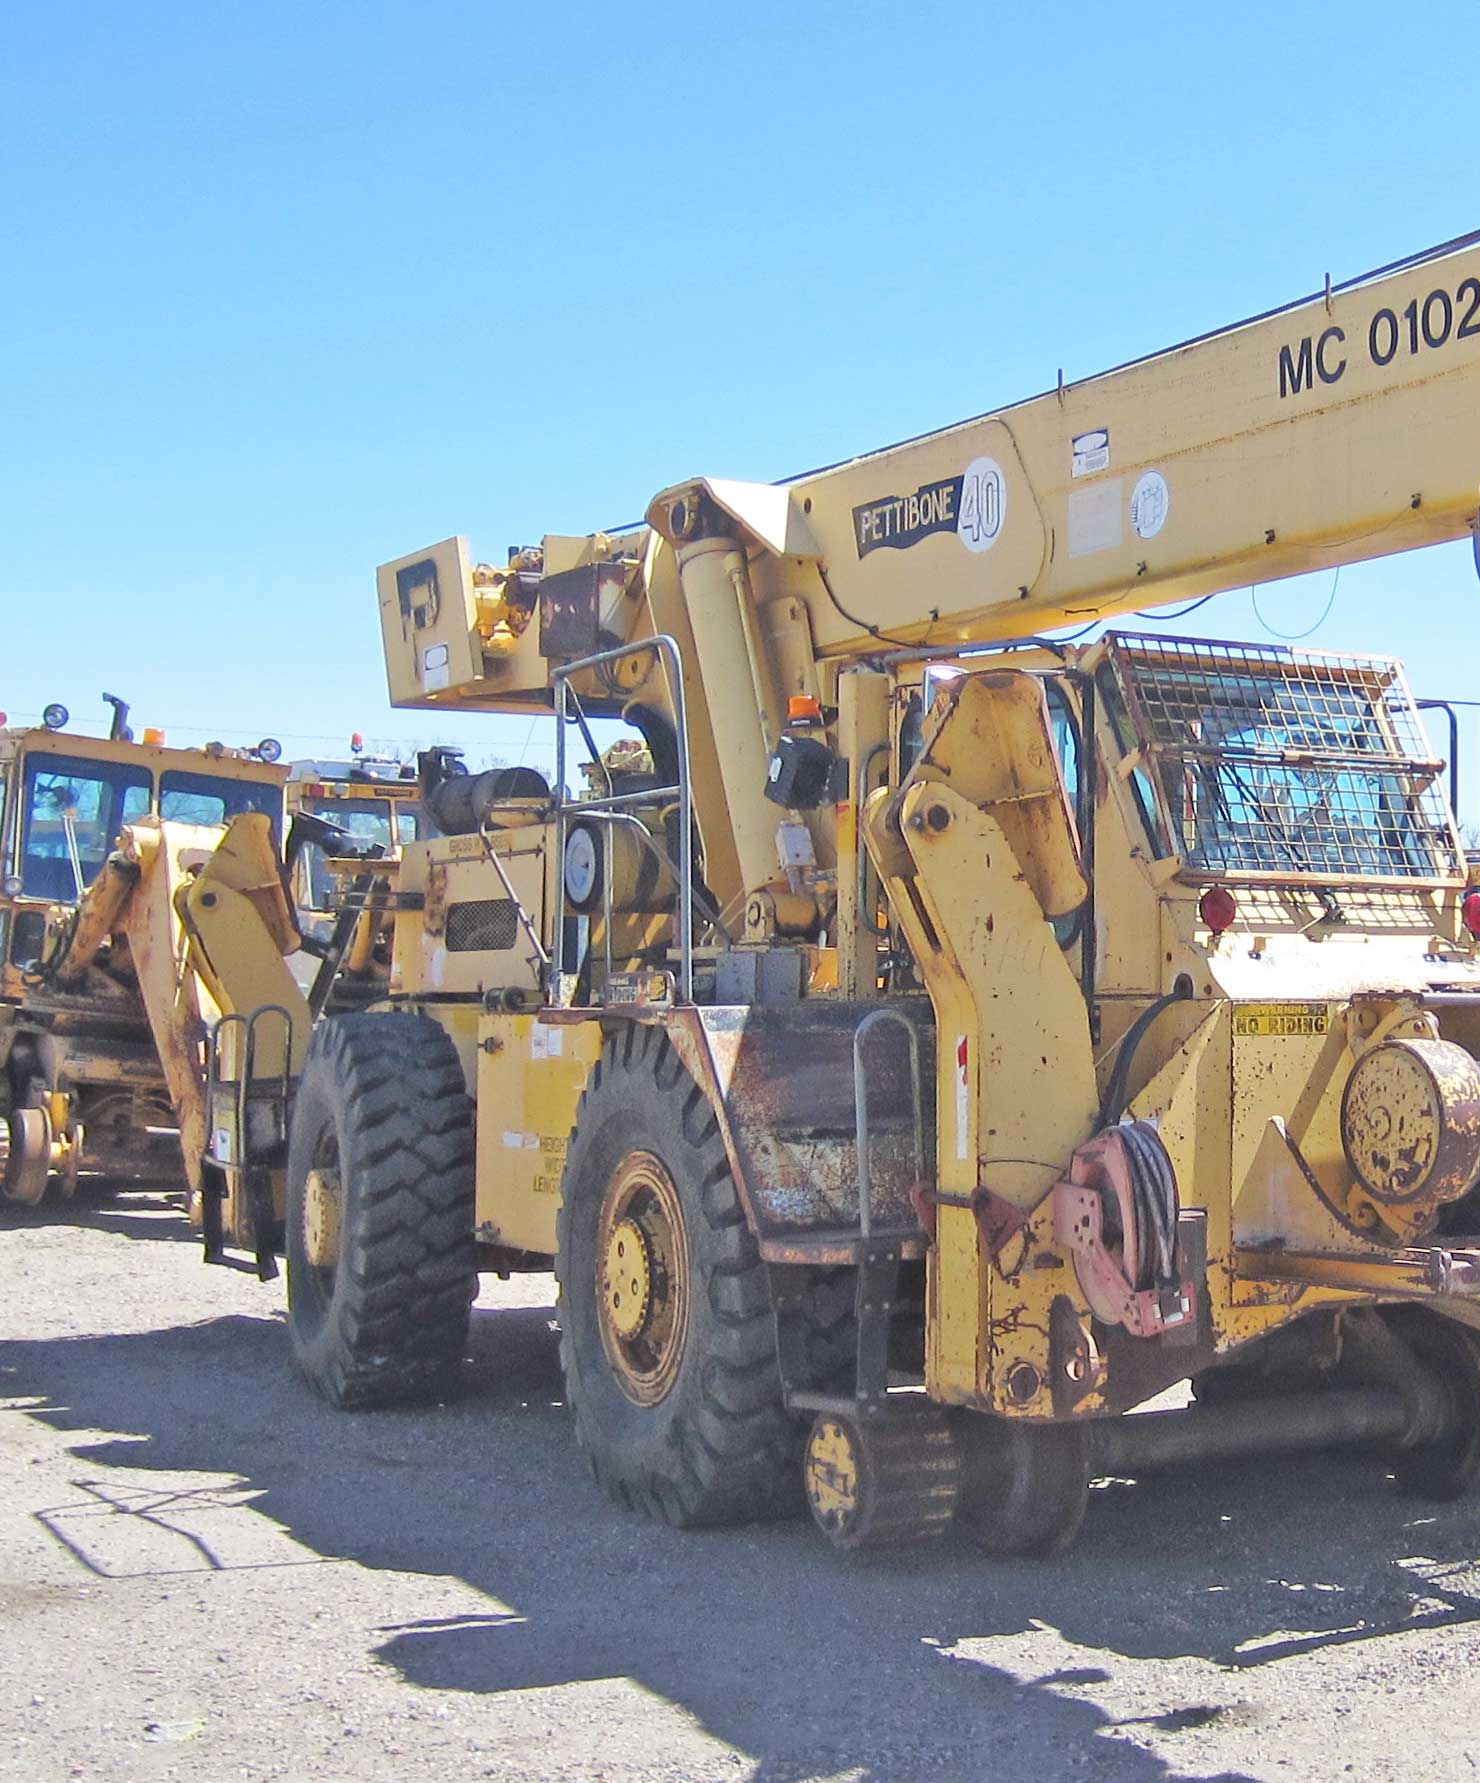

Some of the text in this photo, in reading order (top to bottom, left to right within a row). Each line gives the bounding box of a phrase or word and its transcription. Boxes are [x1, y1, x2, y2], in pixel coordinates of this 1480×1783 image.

[1278, 326, 1347, 398] MC
[860, 470, 1001, 543] PETTIBONE 40
[1235, 1016, 1325, 1034] NO RIDING
